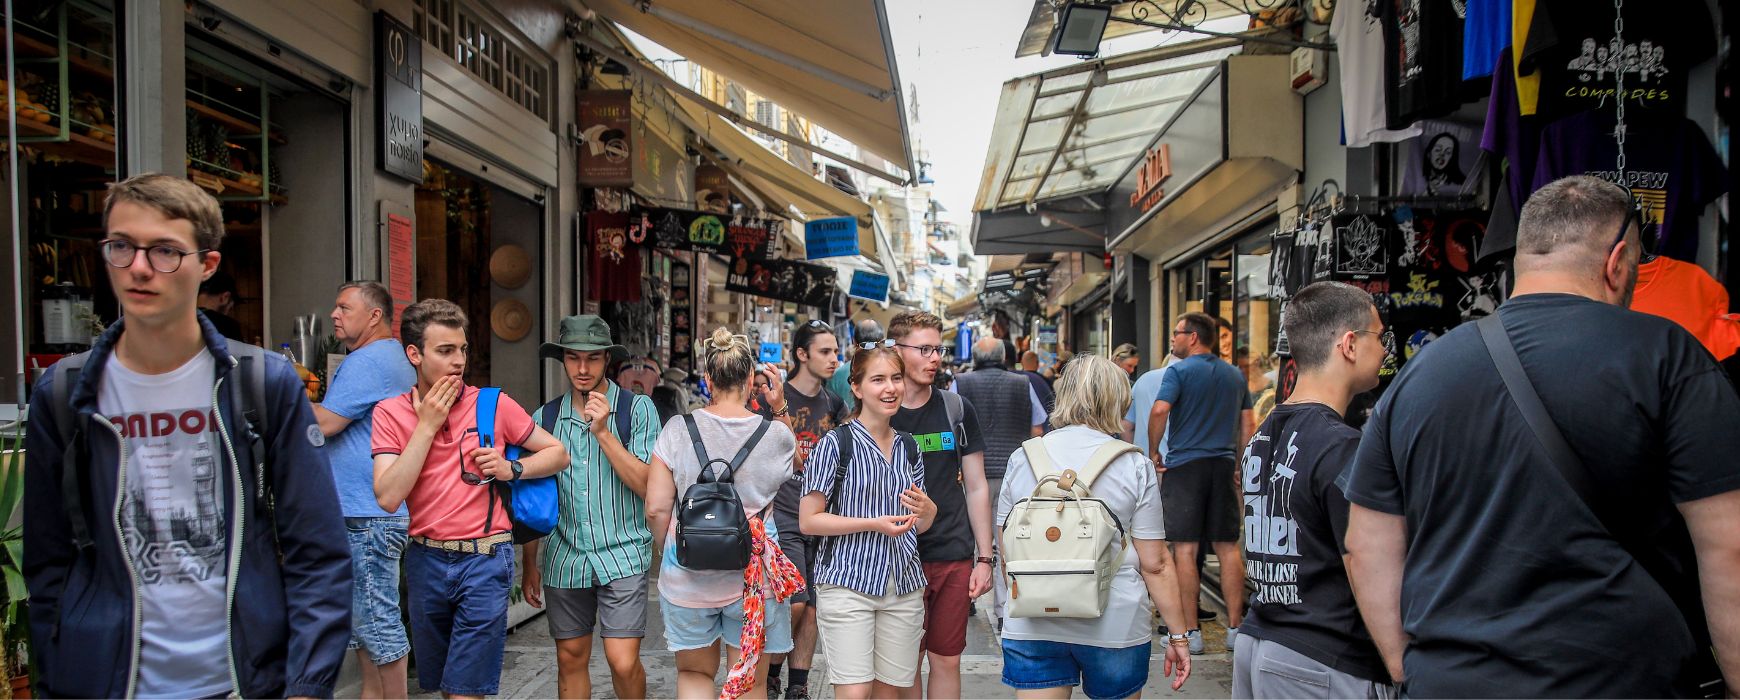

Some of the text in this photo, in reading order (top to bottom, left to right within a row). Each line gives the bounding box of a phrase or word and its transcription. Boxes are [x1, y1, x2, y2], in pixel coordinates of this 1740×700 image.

[1626, 171, 1668, 189] PEW
[729, 273, 749, 288] DNA
[925, 438, 932, 446] N
[1264, 562, 1299, 583] CLOSE
